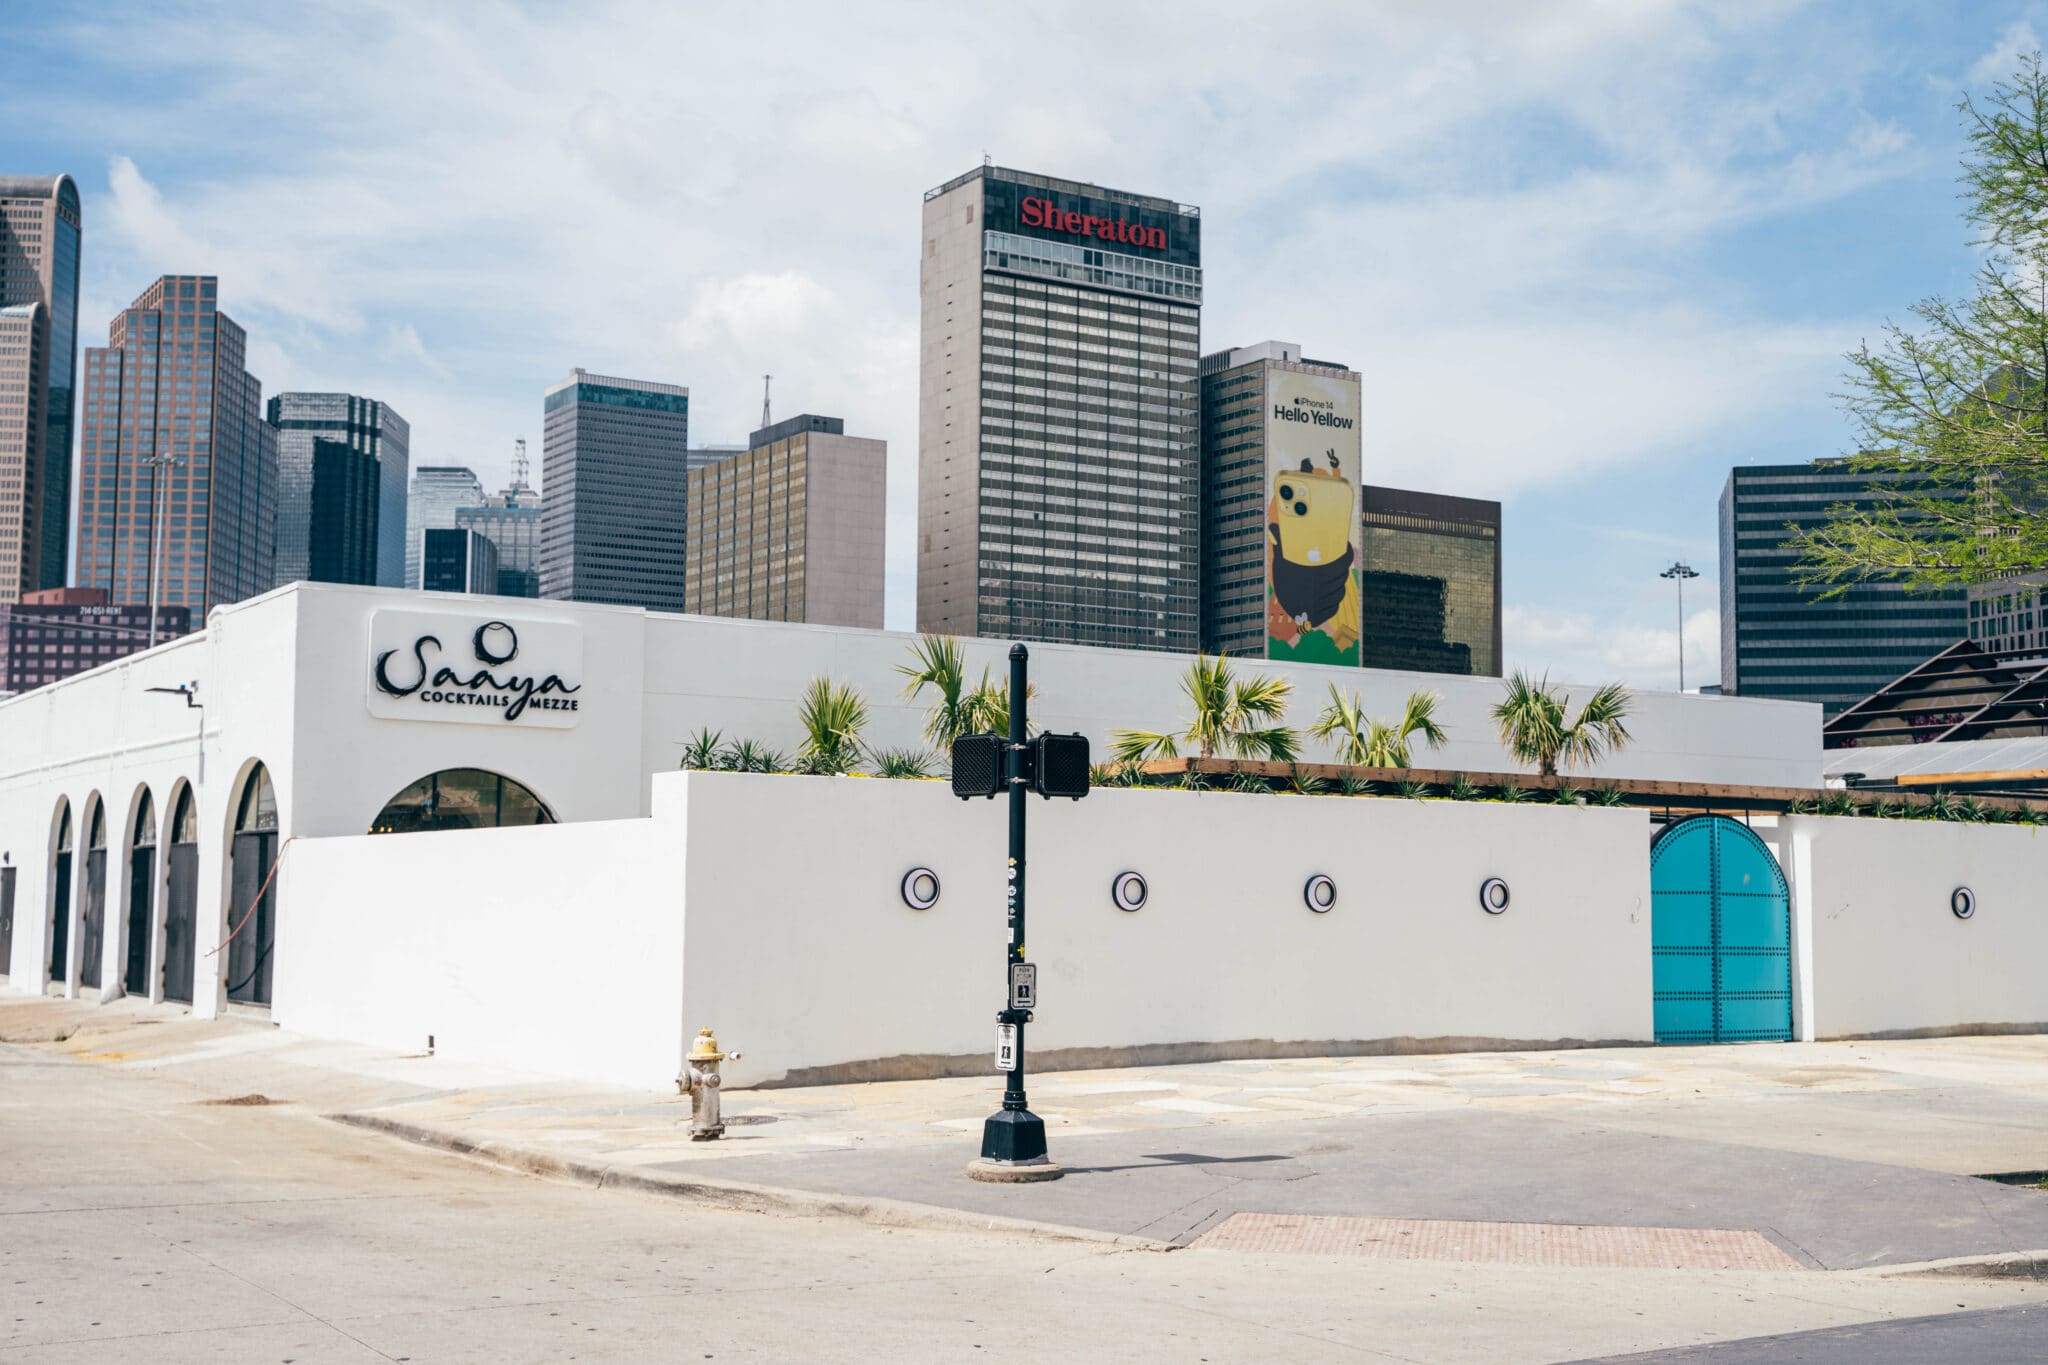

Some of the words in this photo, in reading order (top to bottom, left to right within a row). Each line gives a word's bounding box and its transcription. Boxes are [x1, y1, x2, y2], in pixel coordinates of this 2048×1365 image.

[1021, 196, 1167, 250] Sheraton
[1301, 397, 1325, 409] iPhone
[1326, 401, 1334, 409] 14
[1274, 404, 1309, 424] Hello
[1310, 409, 1353, 429] Yellow
[374, 635, 582, 721] Saaya
[420, 690, 510, 708] COCKTAILS
[529, 697, 579, 711] MEZZE
